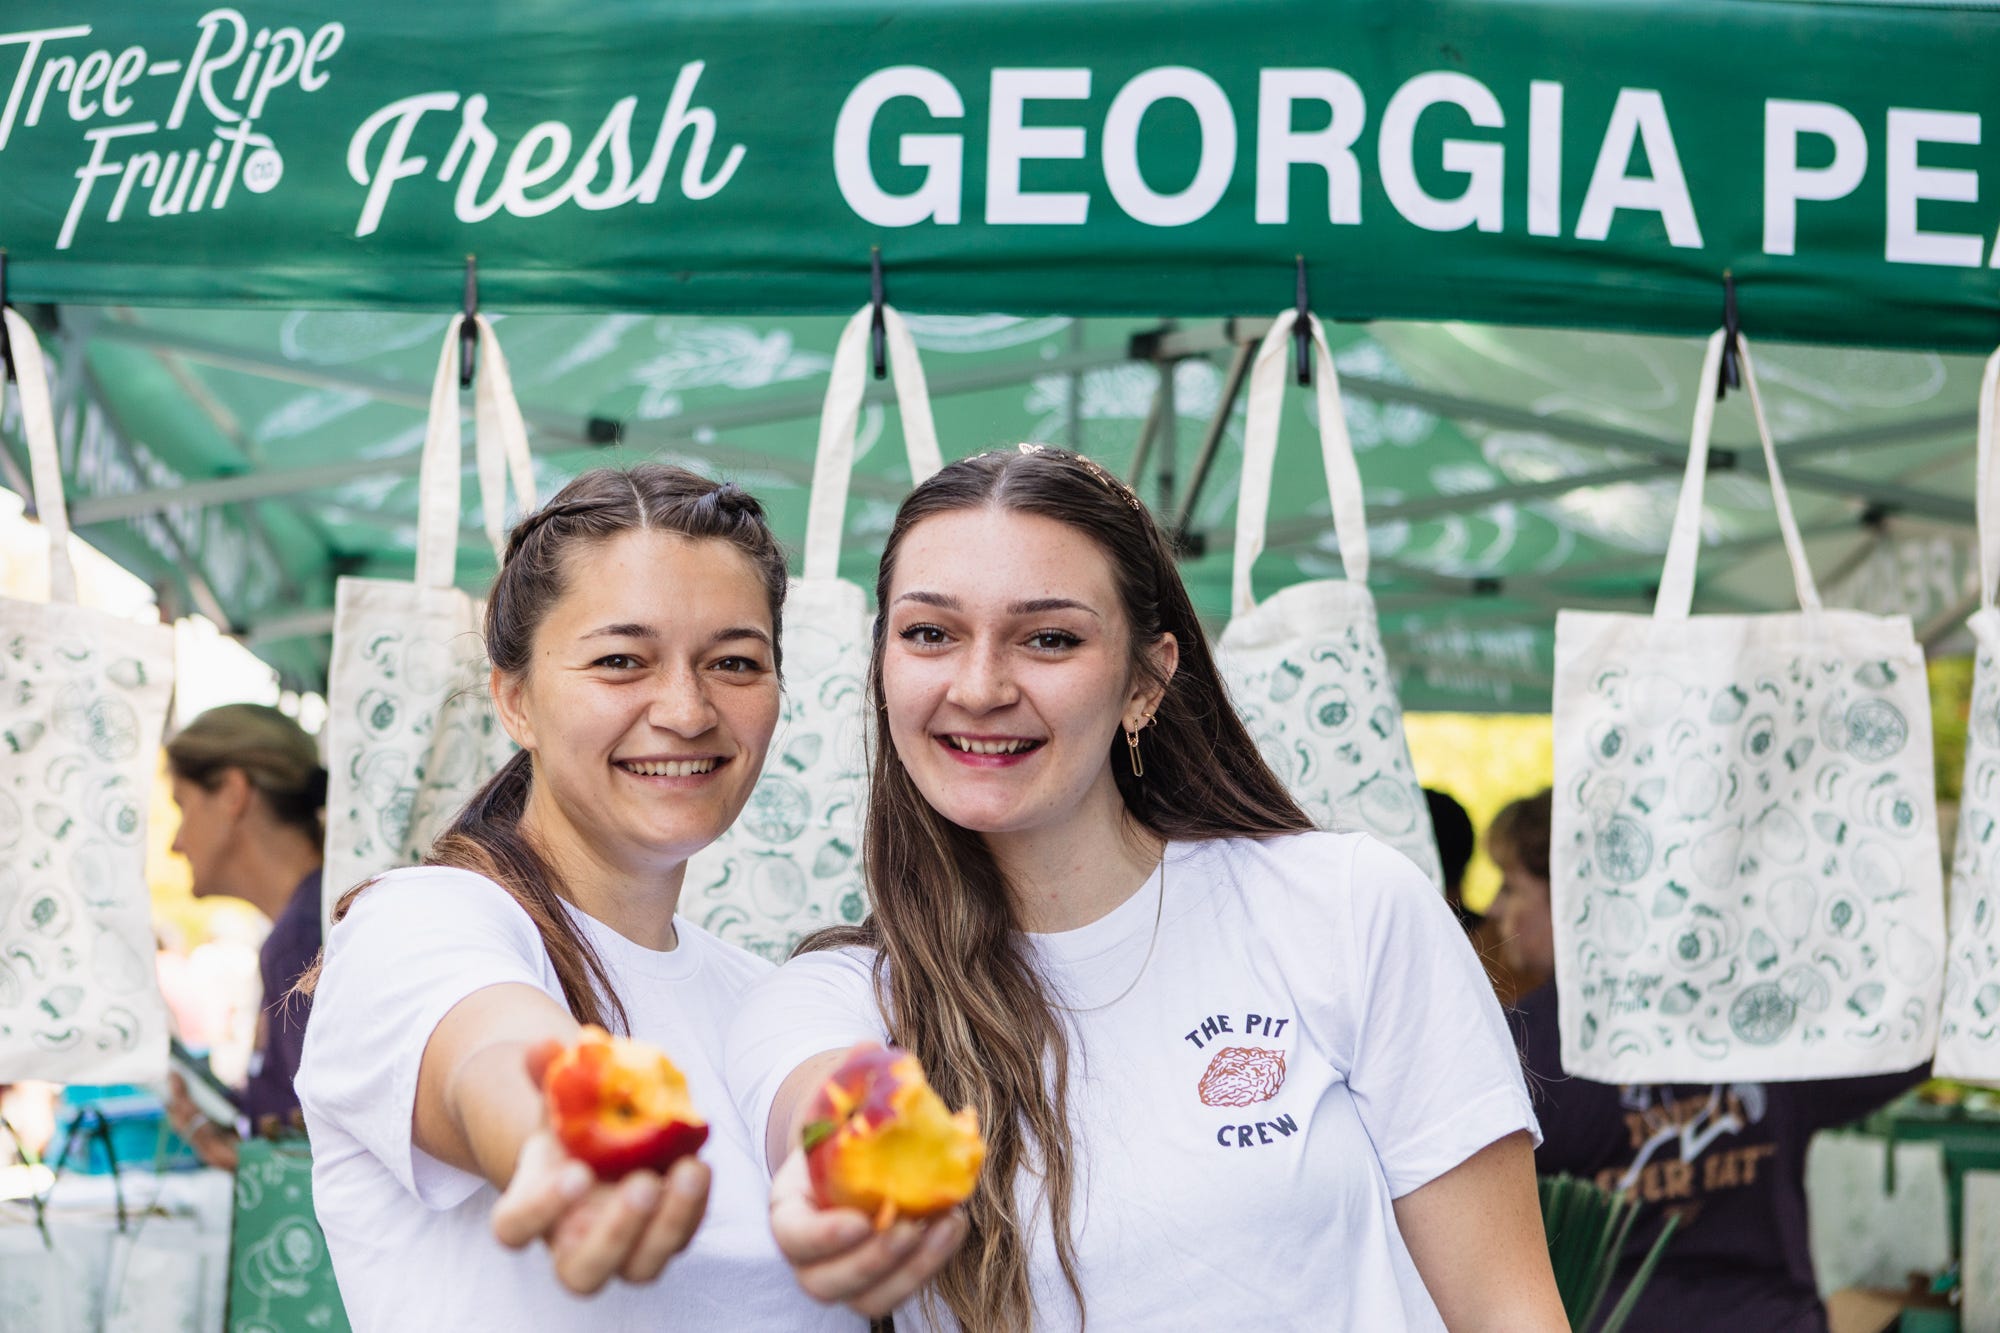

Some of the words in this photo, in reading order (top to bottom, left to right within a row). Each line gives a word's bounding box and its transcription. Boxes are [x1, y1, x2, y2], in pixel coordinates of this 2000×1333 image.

[0, 8, 345, 150] Tree-Ripe
[56, 118, 275, 250] Fruit
[346, 60, 746, 237] Fresh
[832, 65, 1703, 249] GEORGIA
[1762, 98, 2000, 269] PE
[1185, 1014, 1233, 1049] THE
[1245, 1013, 1289, 1038] PIT
[1217, 1113, 1298, 1148] CREW
